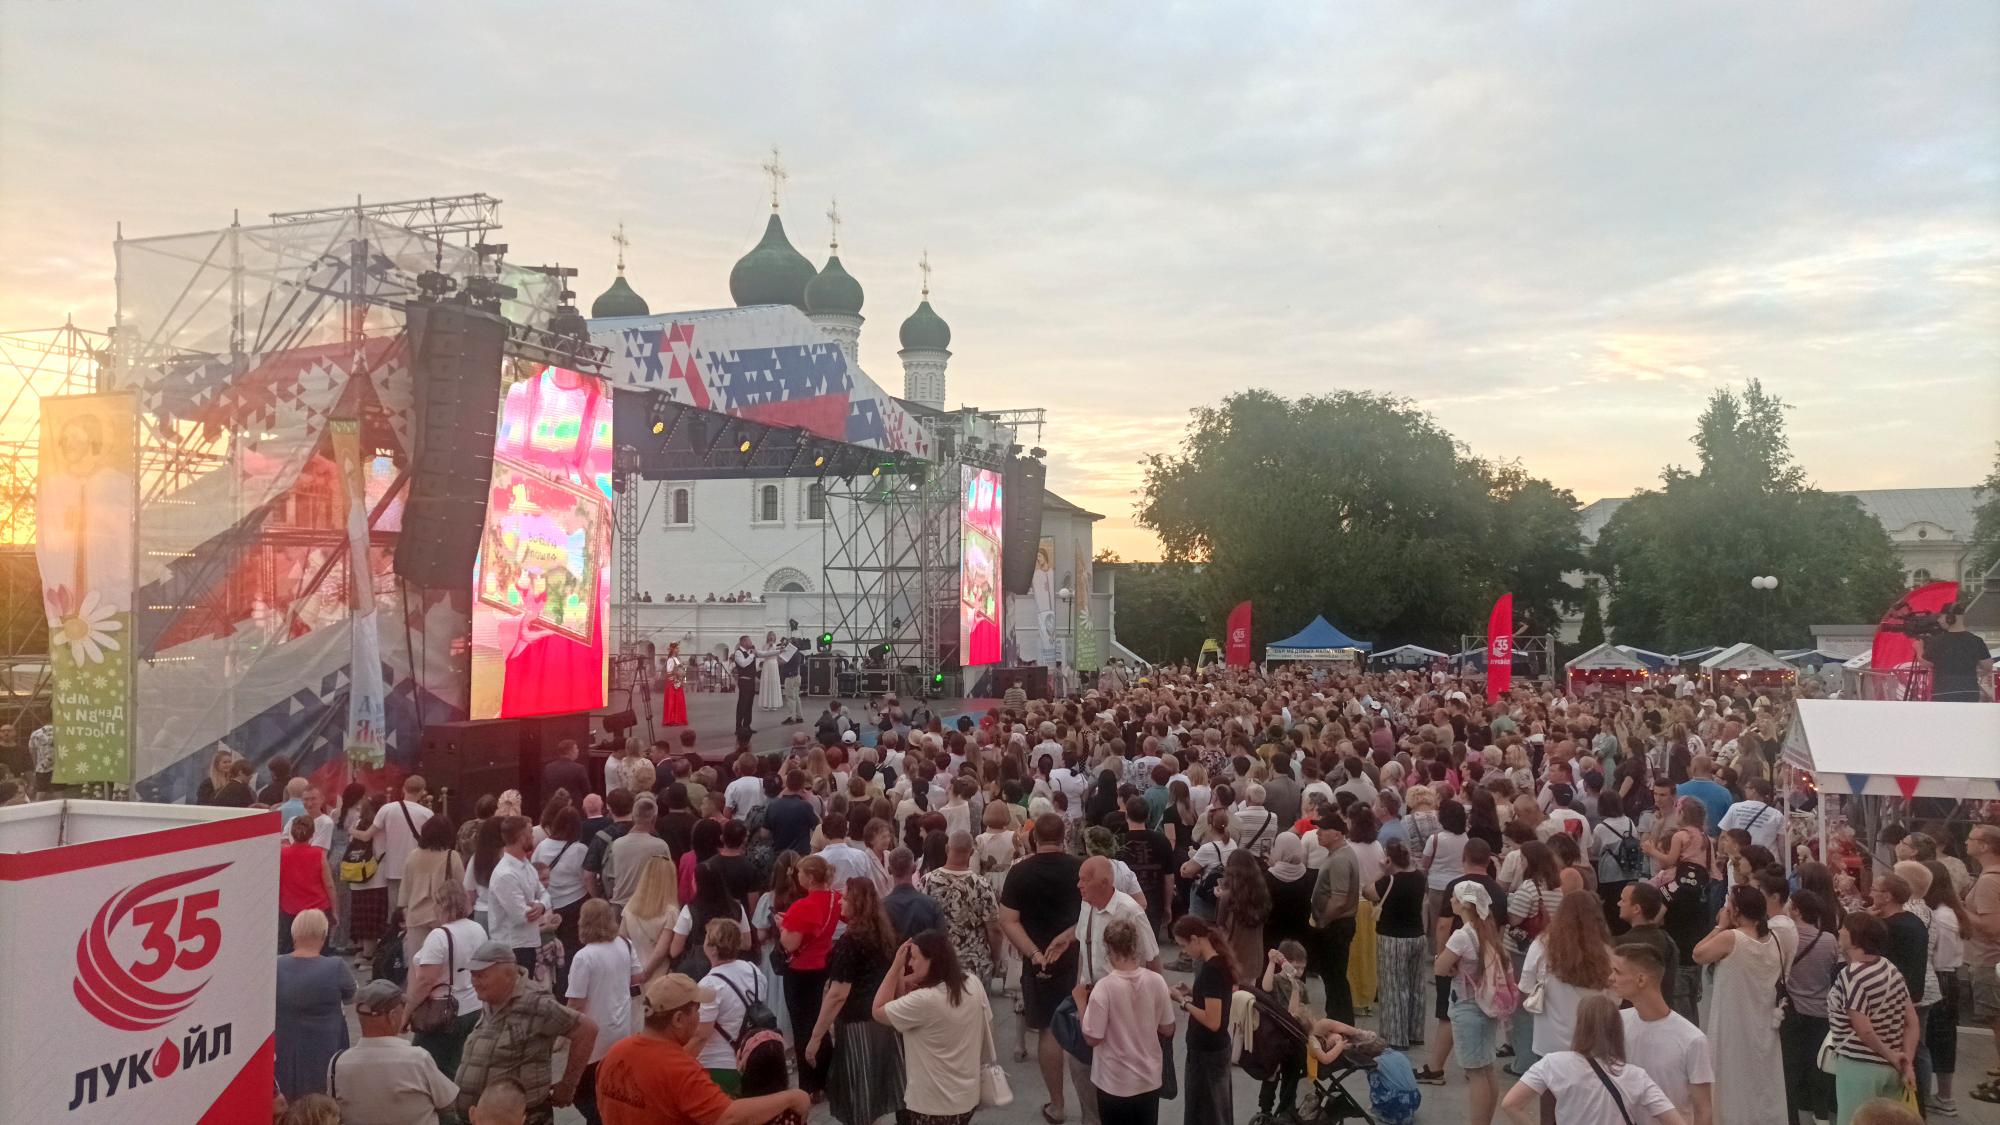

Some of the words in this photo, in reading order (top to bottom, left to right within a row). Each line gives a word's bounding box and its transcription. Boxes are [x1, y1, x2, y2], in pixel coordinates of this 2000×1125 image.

[1495, 639, 1509, 651] 35
[128, 889, 222, 983] 35
[68, 1022, 232, 1111] ЛУКОЙЛ
